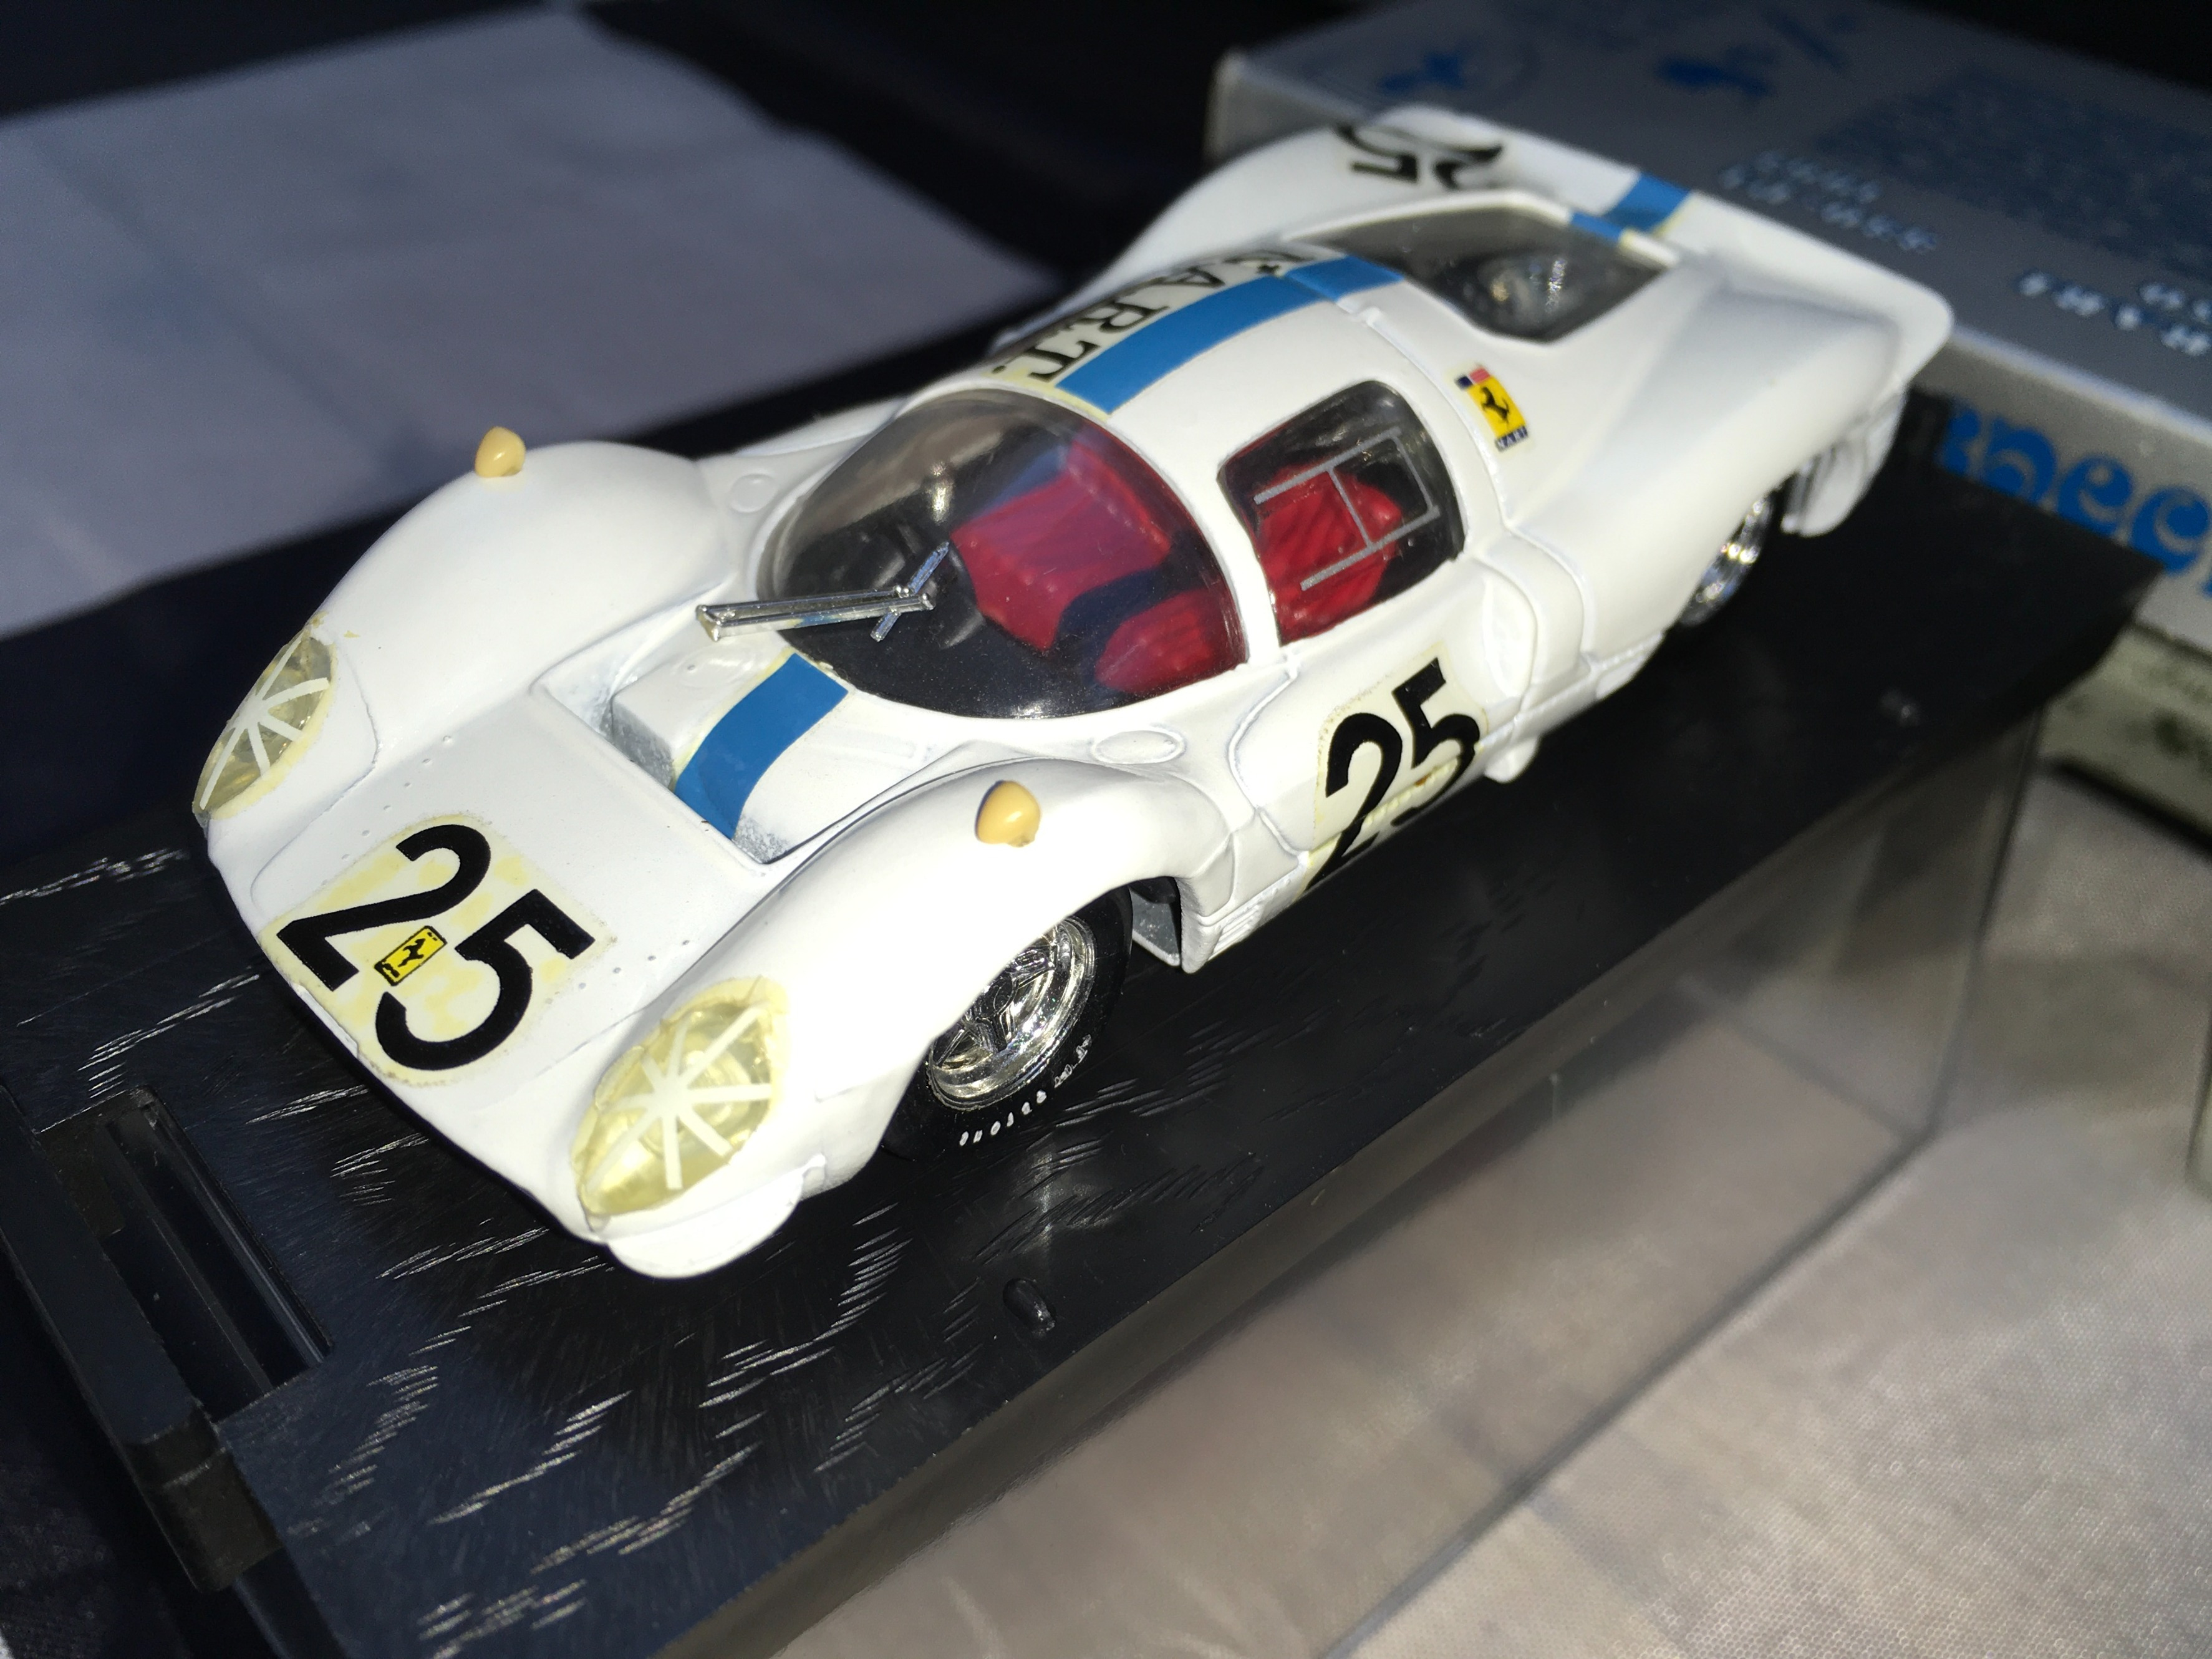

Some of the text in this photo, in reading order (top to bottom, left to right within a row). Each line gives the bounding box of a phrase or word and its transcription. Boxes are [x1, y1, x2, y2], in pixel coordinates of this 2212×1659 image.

[1331, 121, 1505, 190] 25
[1305, 657, 1480, 892] 25
[276, 824, 596, 1071] 25
